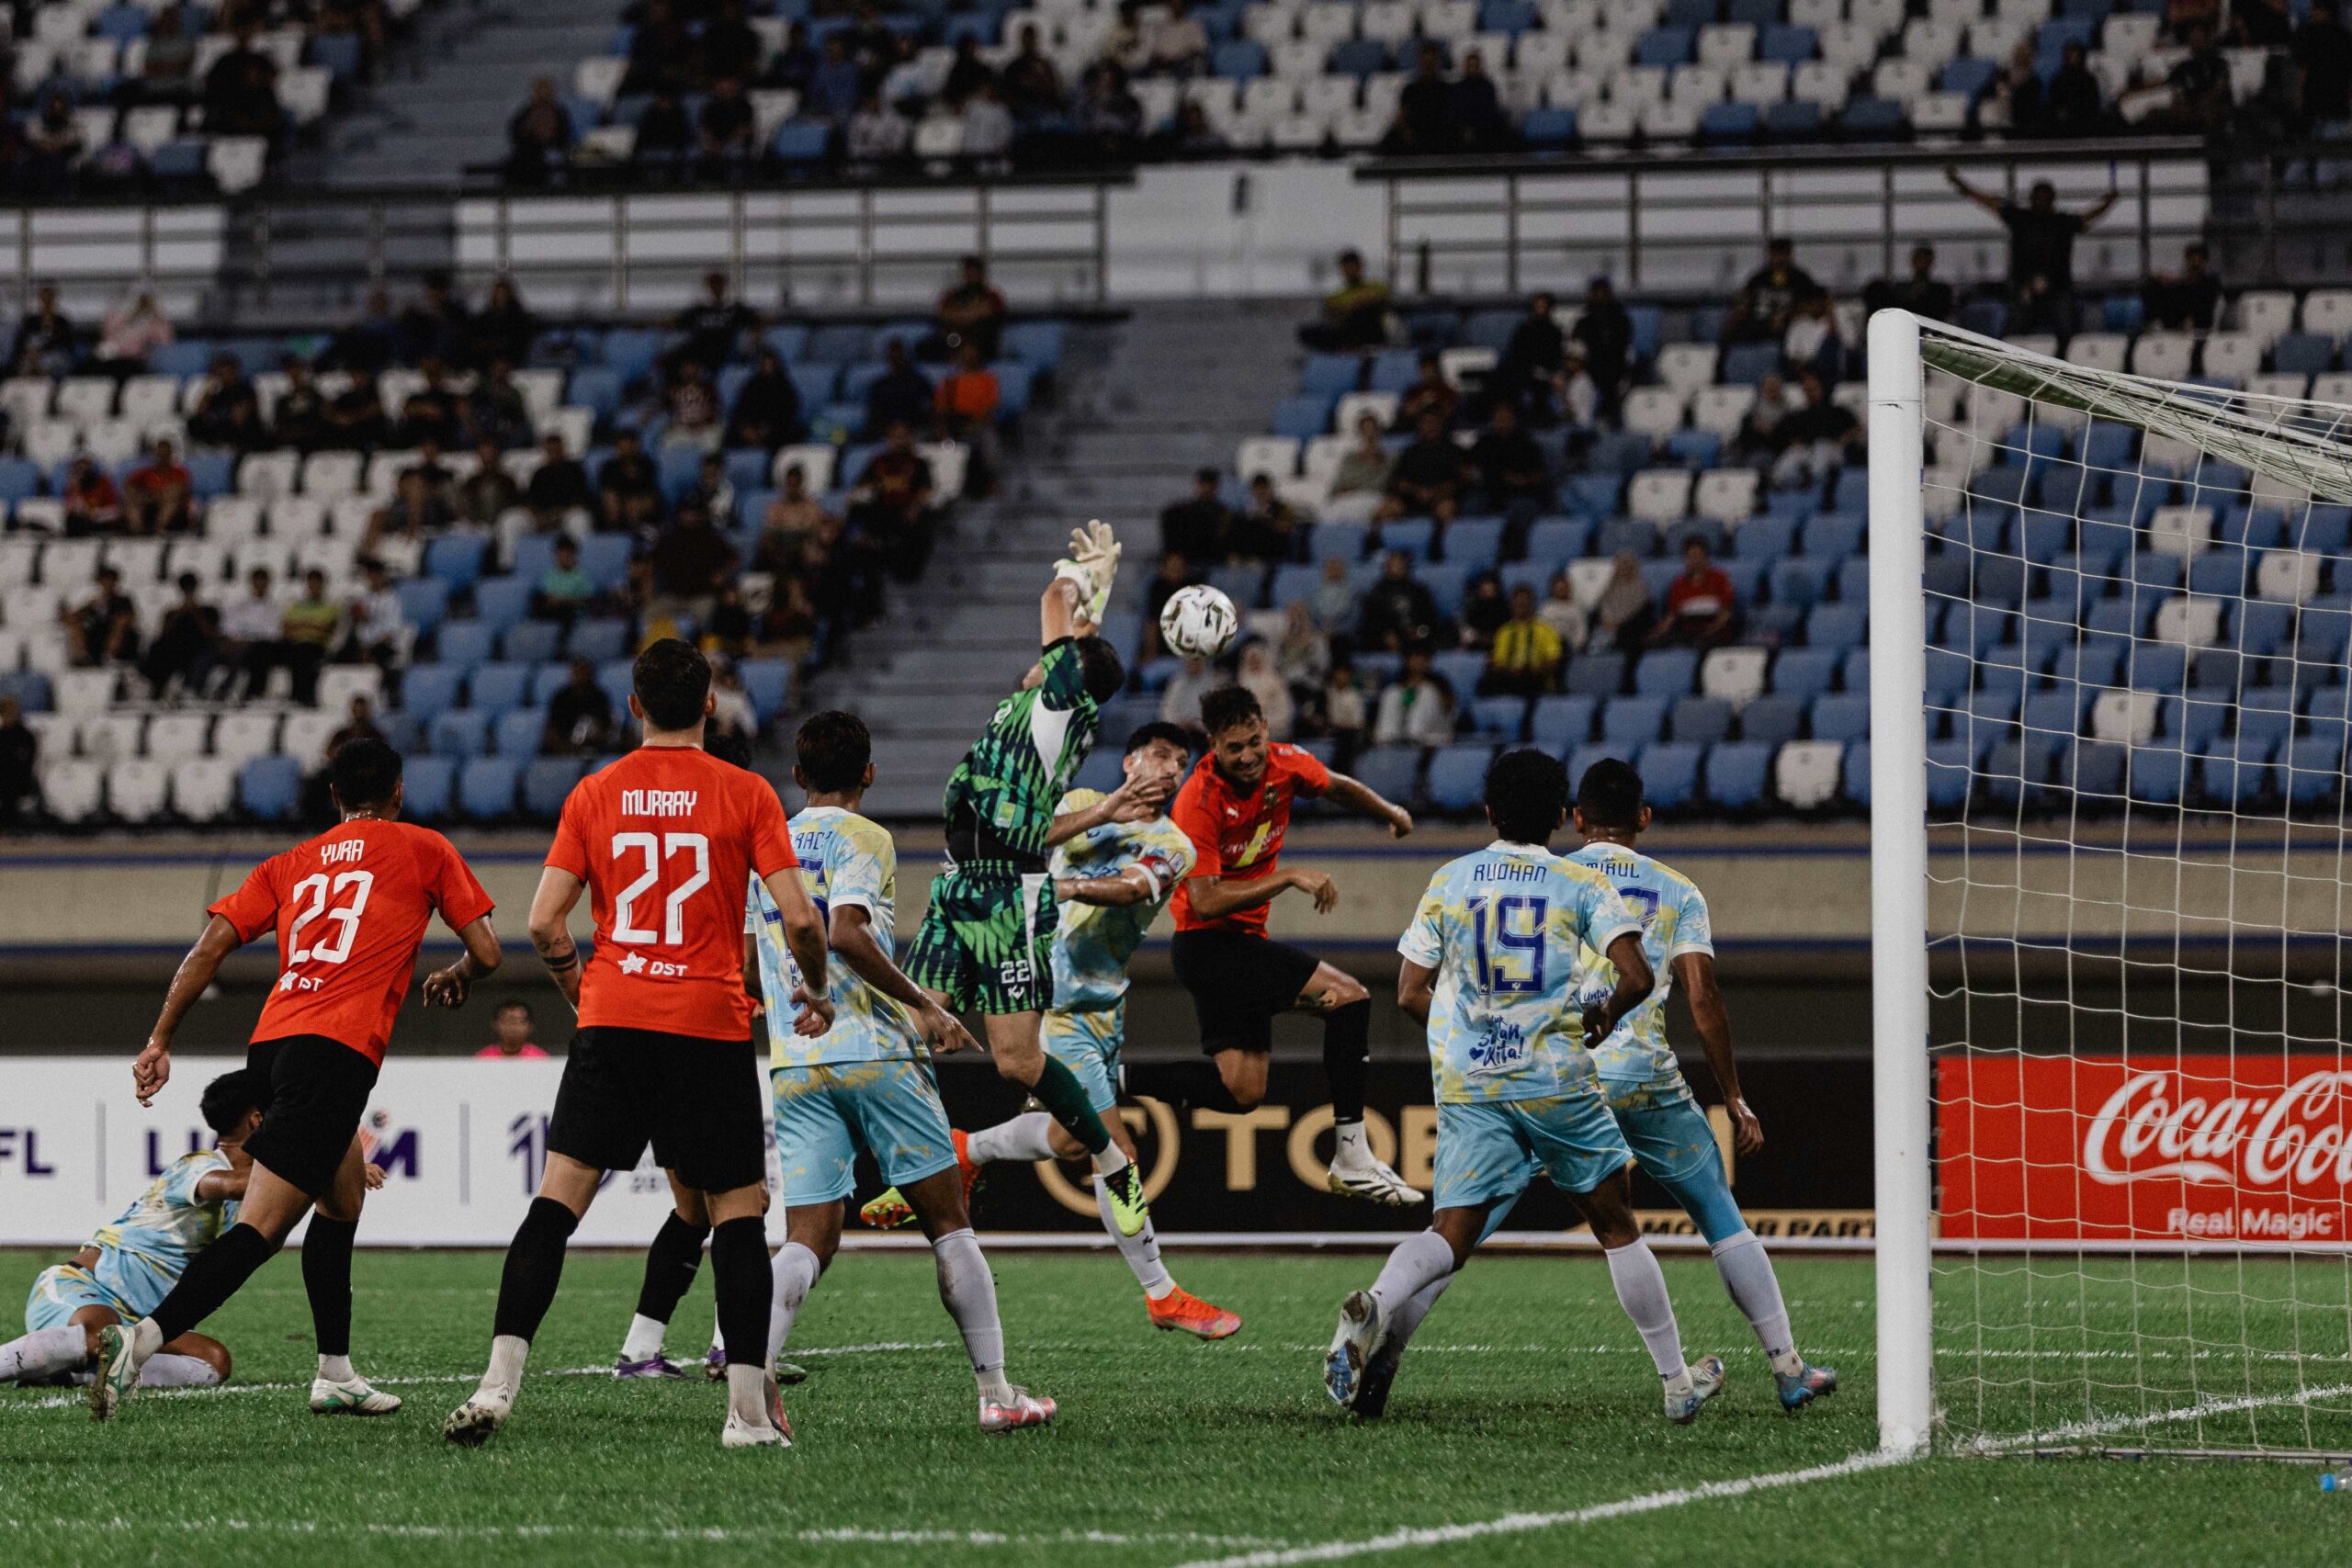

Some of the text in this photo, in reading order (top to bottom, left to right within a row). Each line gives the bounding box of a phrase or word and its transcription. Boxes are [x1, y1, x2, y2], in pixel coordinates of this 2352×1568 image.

[622, 789, 697, 817] MURRAY
[321, 840, 365, 865] YURA
[612, 832, 710, 945] 27
[288, 870, 374, 967] 23
[1464, 895, 1549, 996] 19
[650, 961, 688, 976] DST
[1001, 960, 1030, 984] 22
[2166, 1206, 2334, 1239] Real Magic
